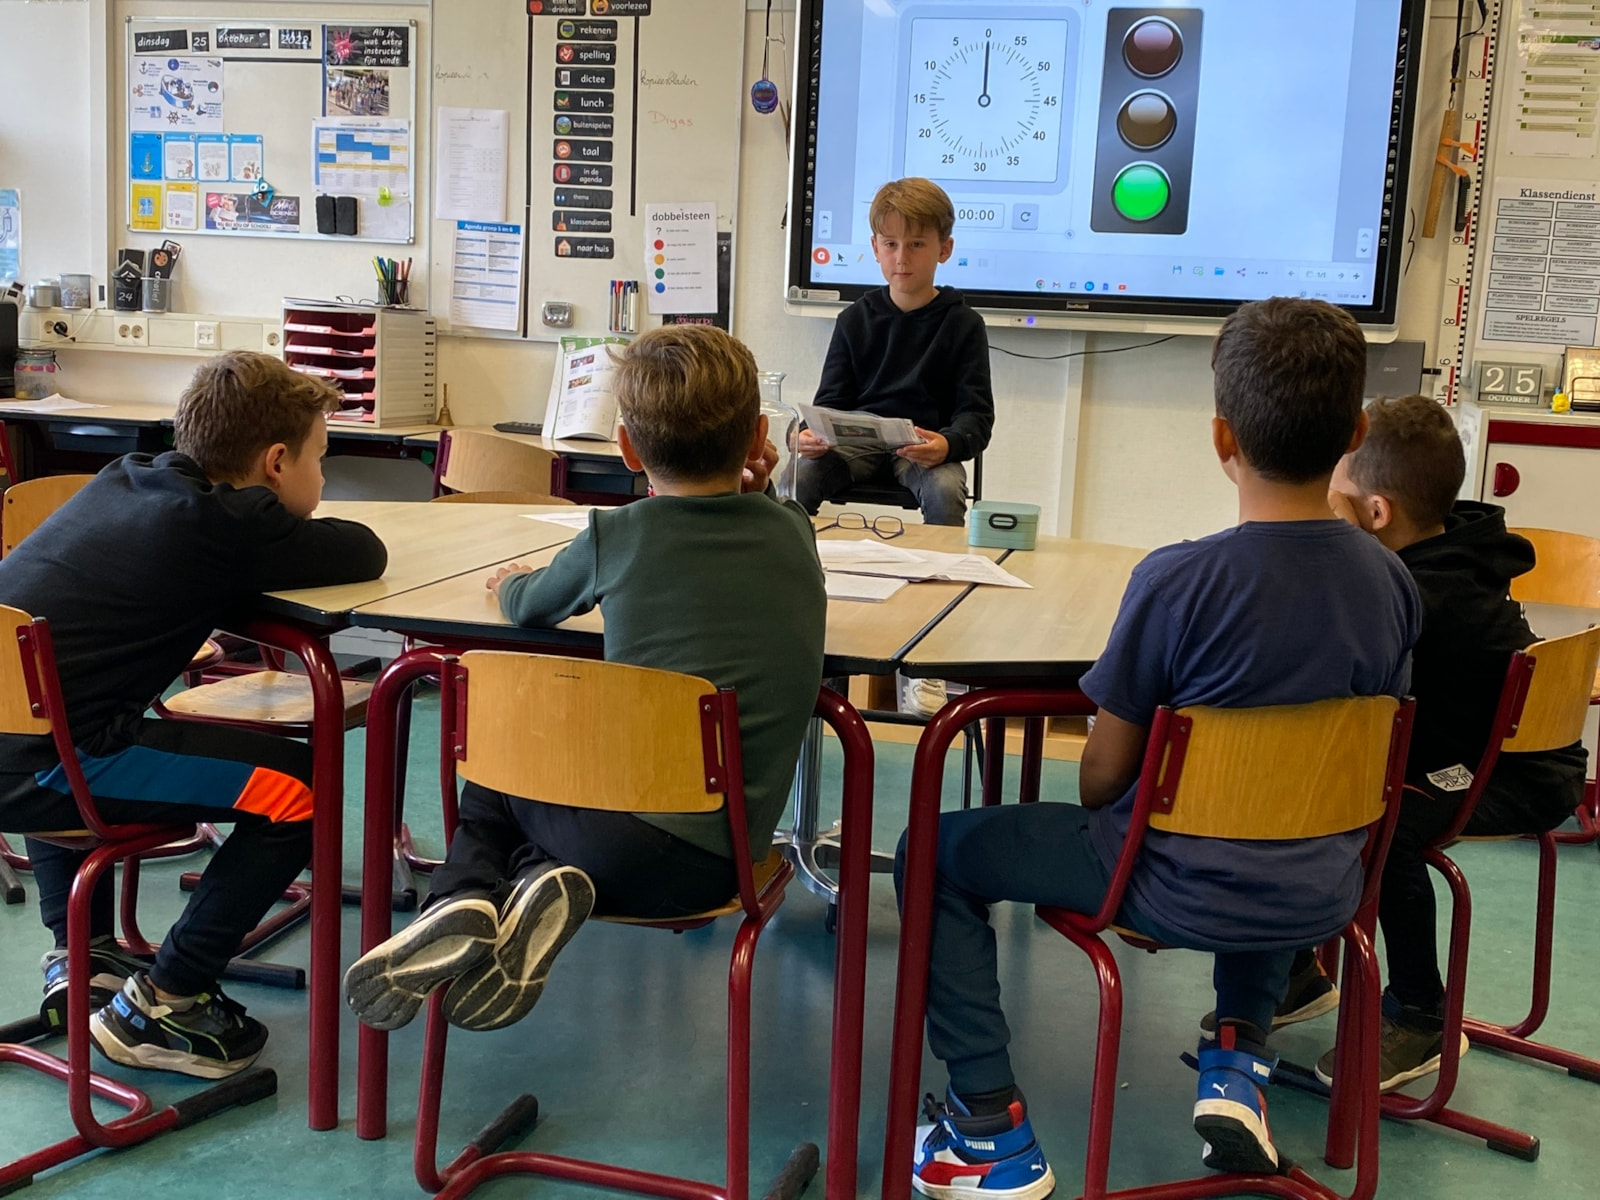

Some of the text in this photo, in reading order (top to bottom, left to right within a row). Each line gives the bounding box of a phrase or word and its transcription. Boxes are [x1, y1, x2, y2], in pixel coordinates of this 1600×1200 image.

[611, 2, 648, 10] voorlezen
[372, 28, 395, 38] Als je
[580, 26, 611, 34] rekenen
[985, 28, 992, 38] 0
[137, 38, 170, 48] dinsdag
[193, 36, 207, 47] 25
[218, 33, 255, 44] oktober
[382, 38, 403, 46] extra
[952, 36, 1028, 46] 5 55
[364, 56, 400, 65] fijn vindt
[579, 50, 611, 61] spelling
[924, 60, 1051, 71] 10 50
[580, 74, 605, 83] dictee
[1469, 70, 1481, 78] 2
[580, 97, 604, 107] lunch
[914, 94, 1057, 106] 15 45
[1465, 112, 1477, 120] 3
[573, 120, 611, 130] buitenspelen
[918, 128, 1046, 141] 20 40
[582, 146, 599, 156] taal
[941, 154, 1019, 166] 25 35
[1460, 153, 1472, 161] 4
[973, 162, 987, 172] 30
[579, 176, 602, 184] agenda
[1519, 188, 1596, 200] Klassendienst
[652, 212, 710, 221] dobbelsteen
[958, 209, 995, 221] 00:00
[570, 218, 610, 226] klassendienst
[1452, 236, 1464, 244] 6
[594, 244, 609, 252] huis
[1449, 277, 1460, 285] 7
[152, 271, 161, 304] creatief
[118, 291, 133, 302] 24
[1443, 317, 1455, 325] 8
[1515, 314, 1567, 323] SPELREGELS
[1439, 358, 1451, 366] 9
[1484, 367, 1536, 394] 25
[1487, 394, 1531, 403] OCTOBER
[964, 1139, 995, 1151] PUMA
